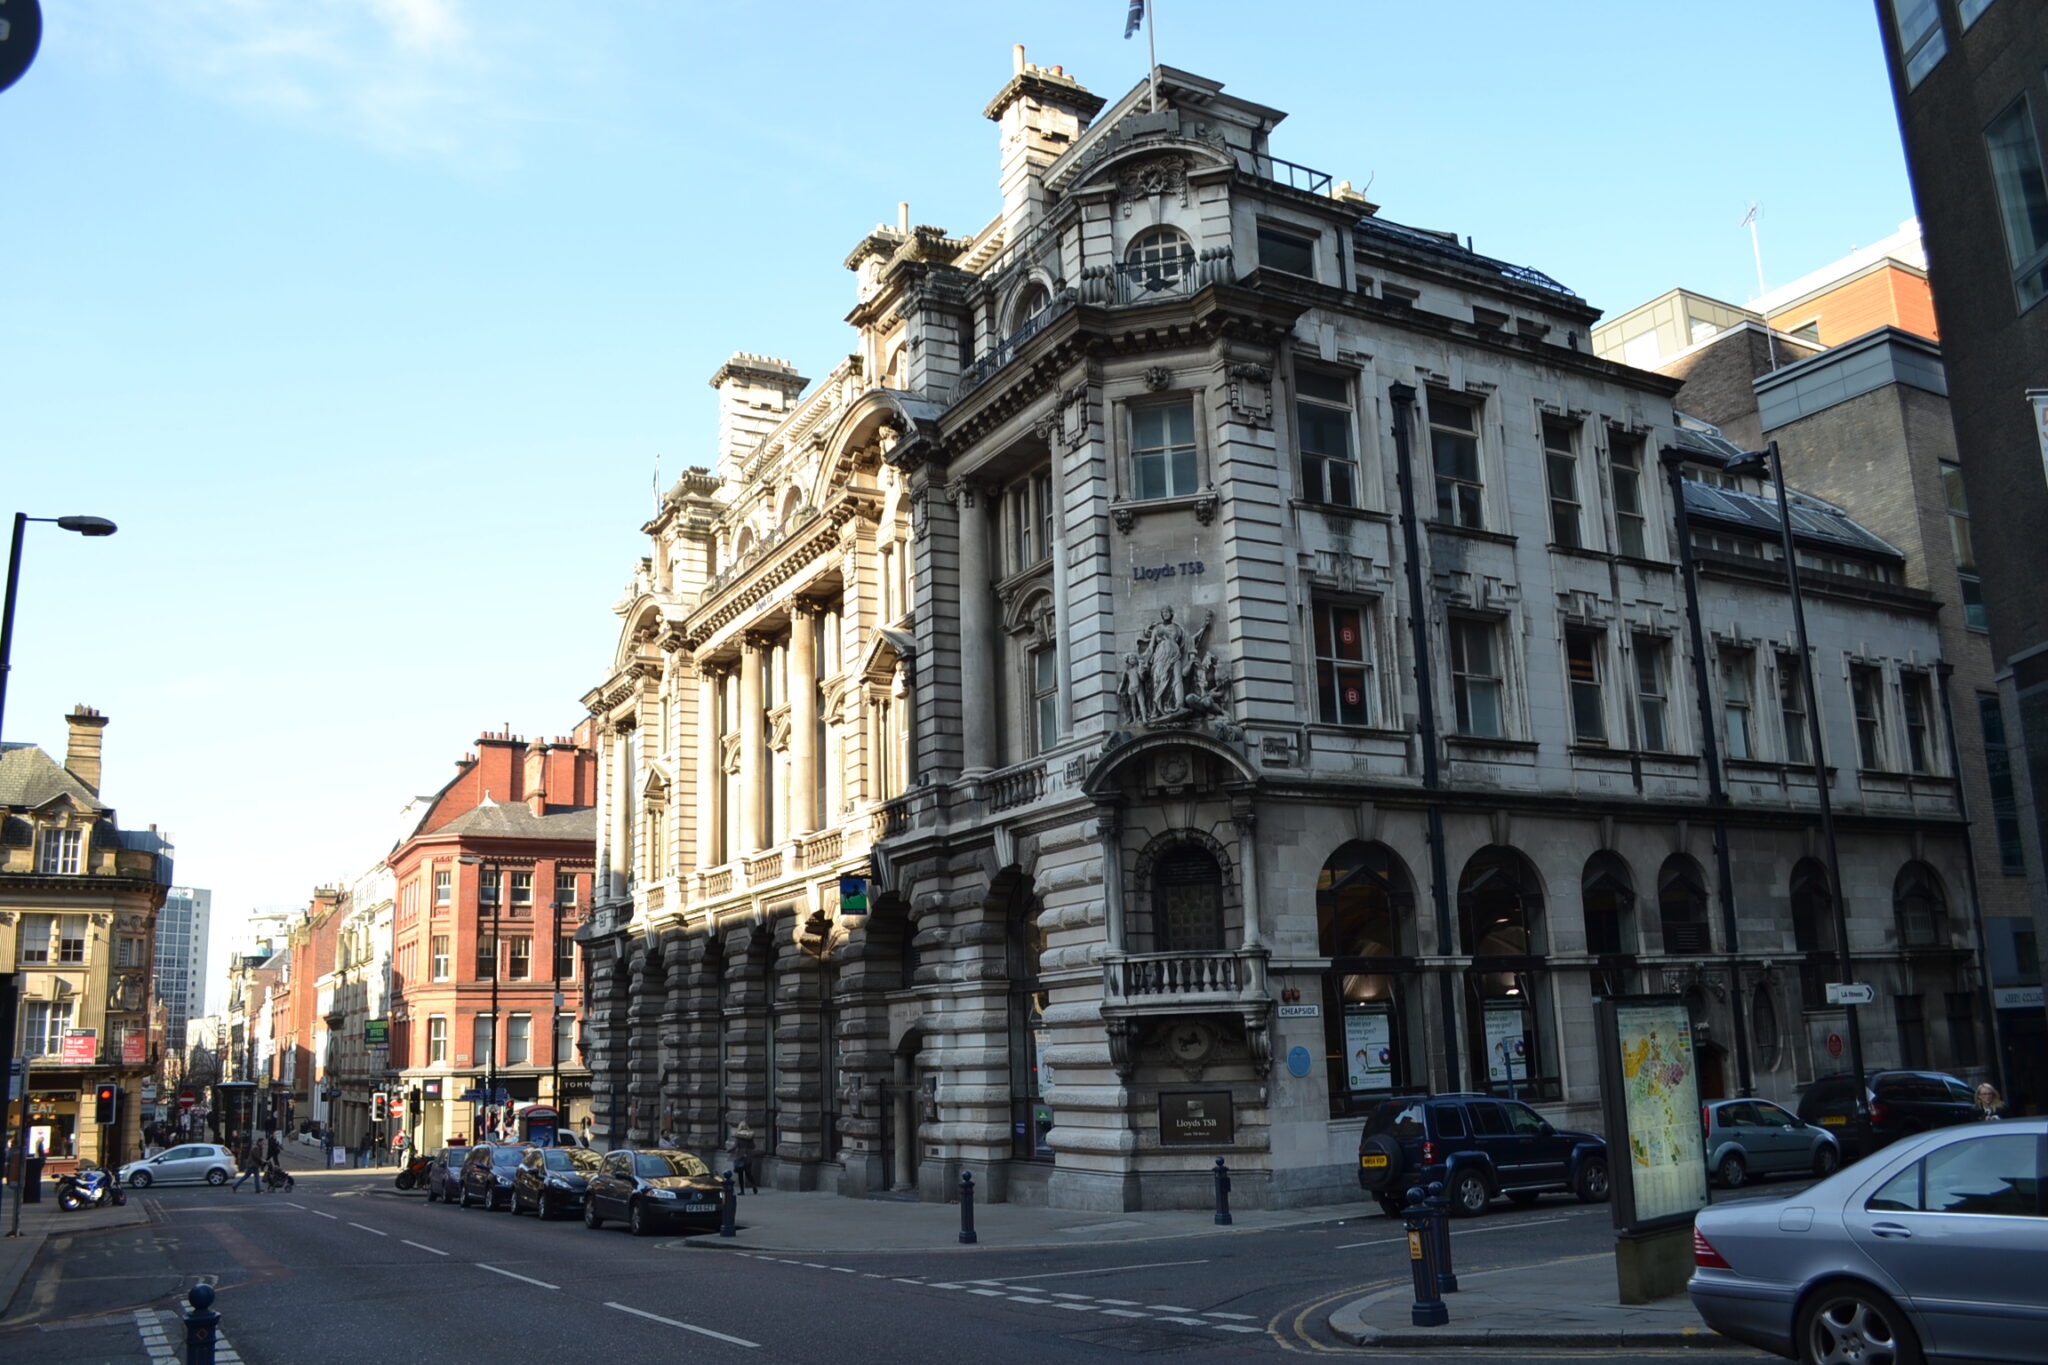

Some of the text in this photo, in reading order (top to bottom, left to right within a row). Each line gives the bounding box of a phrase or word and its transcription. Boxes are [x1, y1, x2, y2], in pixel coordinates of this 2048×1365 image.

[1133, 561, 1205, 581] Lloyds TSB
[1281, 1007, 1316, 1015] CHEAPSIDE
[29, 1103, 57, 1113] EAT.
[1176, 1119, 1216, 1129] Lloyds TSB
